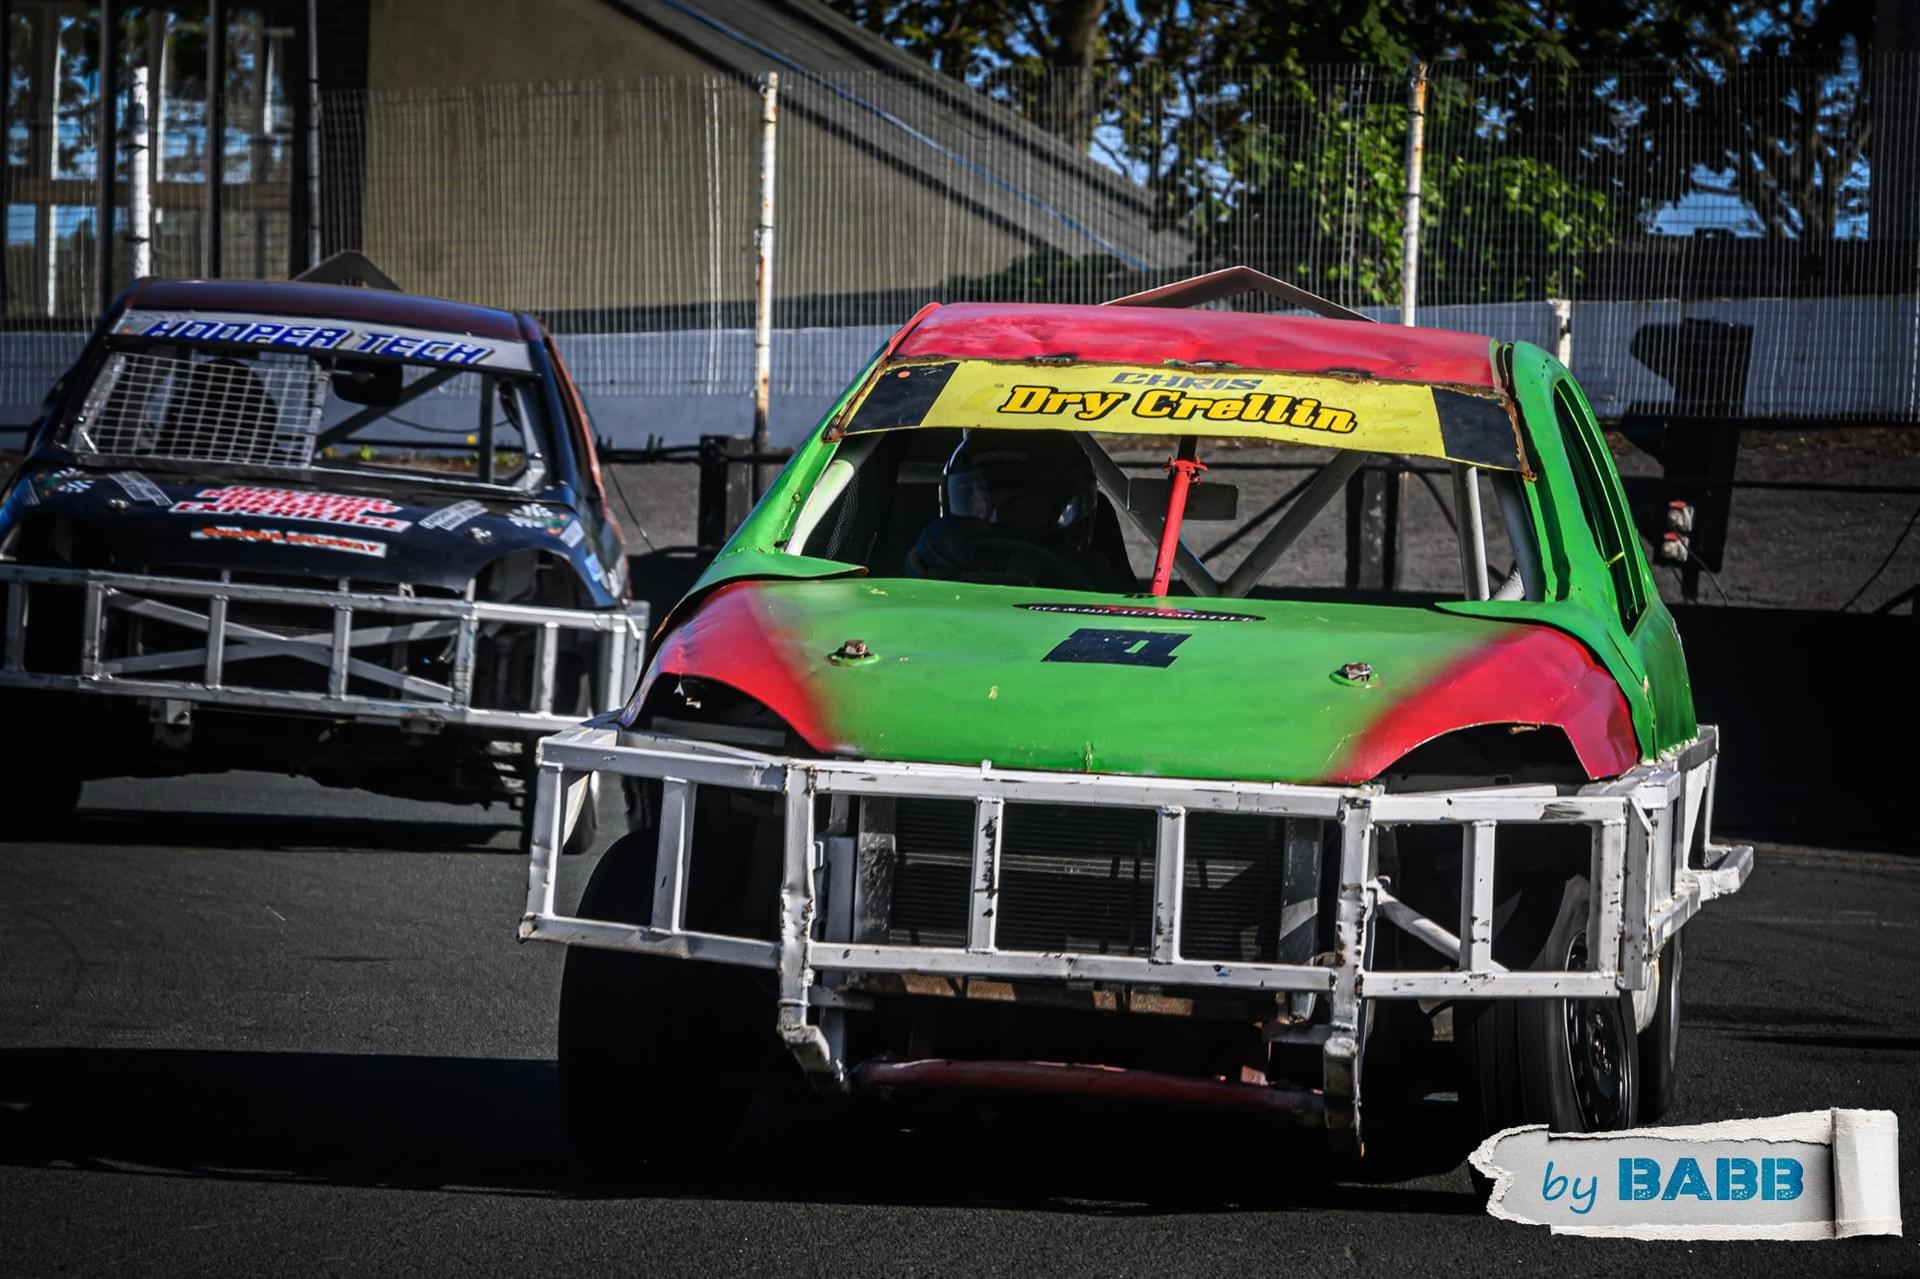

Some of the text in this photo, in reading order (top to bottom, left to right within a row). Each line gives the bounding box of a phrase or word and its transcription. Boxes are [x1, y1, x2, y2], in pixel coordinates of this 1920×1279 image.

[142, 320, 494, 365] HOOPER TECH
[1107, 371, 1264, 391] CHRIS
[998, 385, 1360, 434] Dry Crellin
